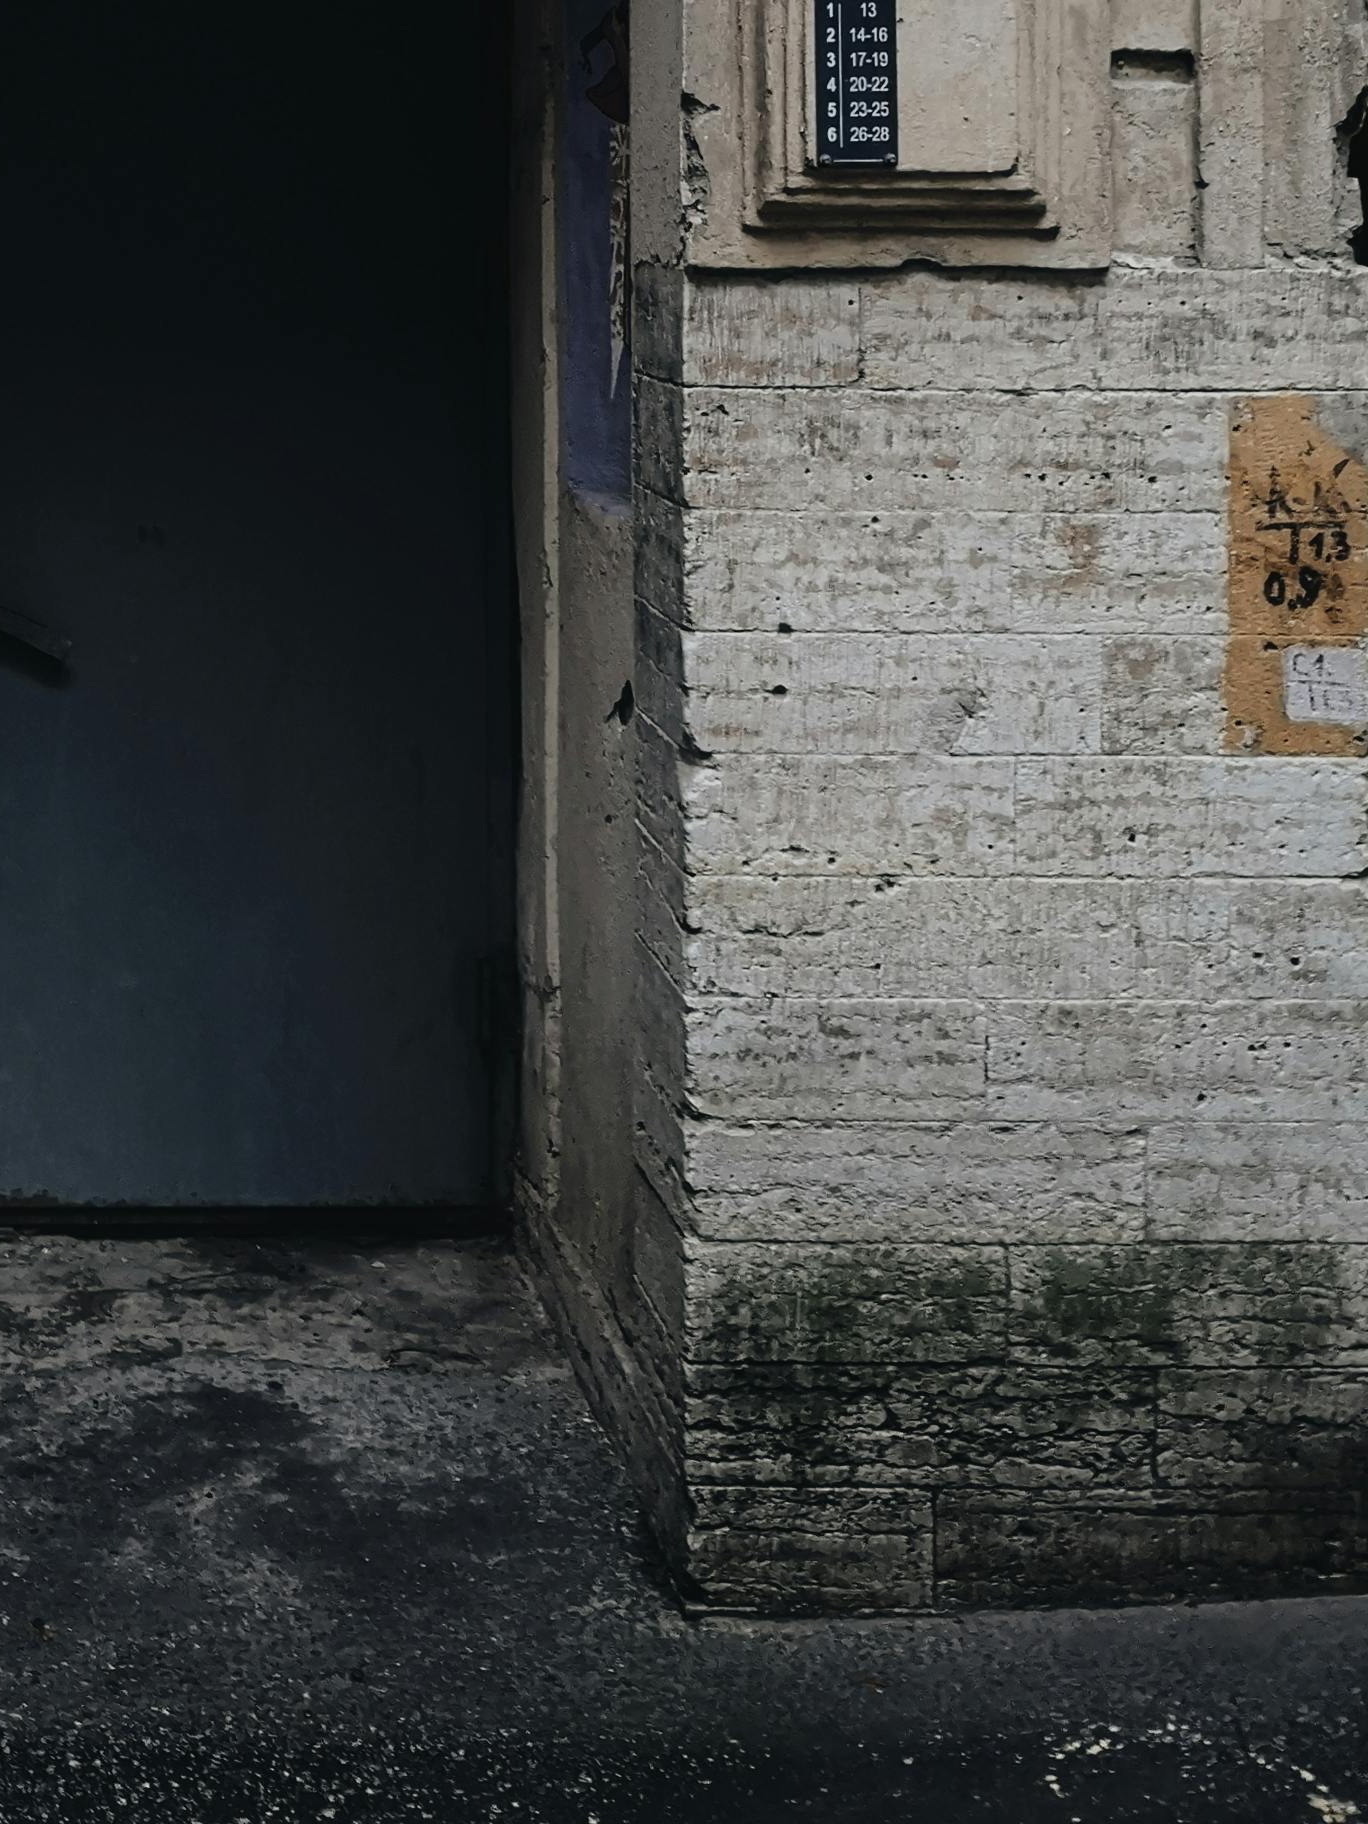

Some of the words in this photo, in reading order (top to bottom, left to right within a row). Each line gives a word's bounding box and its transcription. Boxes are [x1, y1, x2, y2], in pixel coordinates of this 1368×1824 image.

[827, 3, 833, 17] 1
[861, 2, 877, 17] 13
[827, 28, 835, 42] 2
[850, 27, 888, 42] 14-16
[827, 52, 835, 67] 3
[850, 52, 888, 66] 17-19
[827, 77, 836, 92] 4
[850, 77, 888, 92] 20-22
[828, 102, 836, 117] 5
[850, 101, 889, 117] 23-25
[827, 127, 837, 142] 6
[850, 127, 889, 141] 26-28
